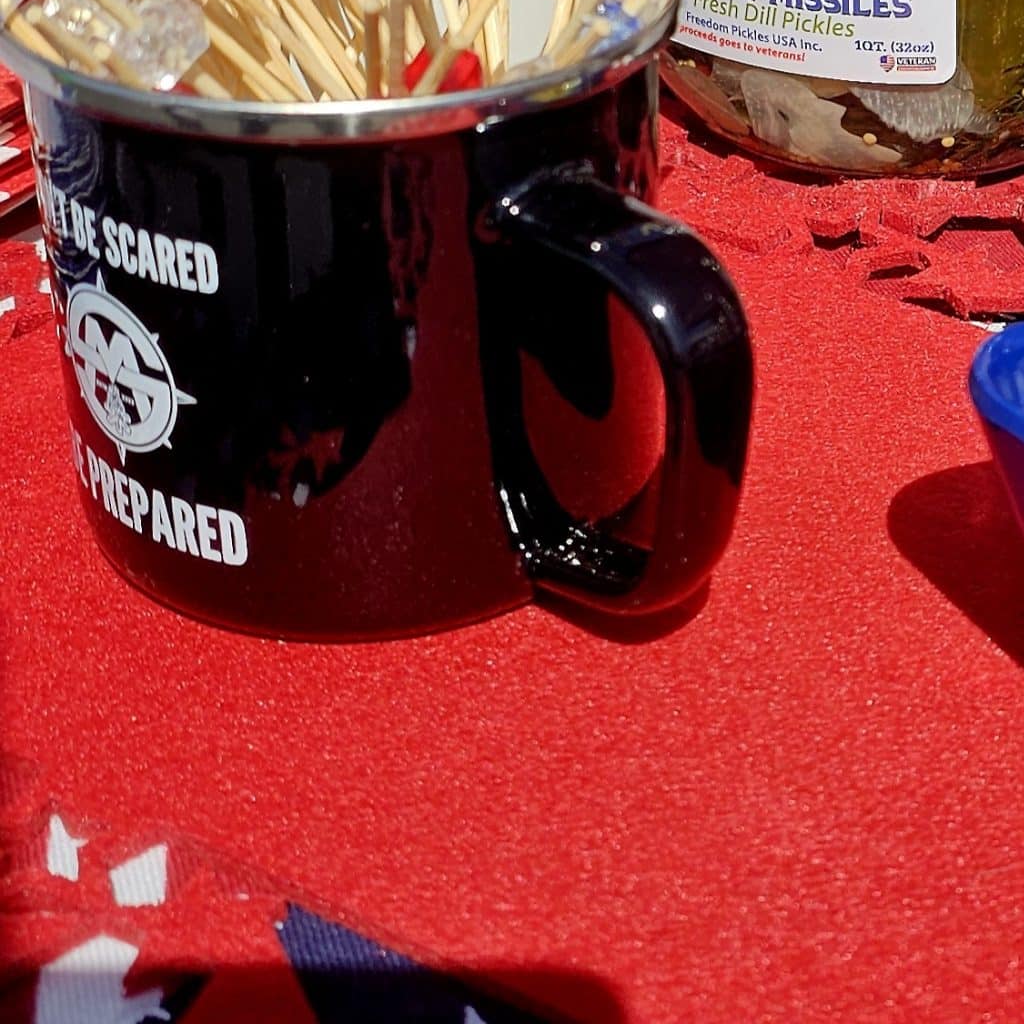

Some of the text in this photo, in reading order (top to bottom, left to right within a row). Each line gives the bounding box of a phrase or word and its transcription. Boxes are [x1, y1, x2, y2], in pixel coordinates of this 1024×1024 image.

[686, 11, 823, 52] Freedom Pickles USA Inc.
[744, 3, 778, 27] Dill
[782, 11, 855, 37] Pickles
[680, 25, 806, 62] proceeds goes to veterans!
[855, 40, 935, 53] 1QT. (32oz)
[70, 197, 100, 260] BE
[102, 216, 219, 295] SCARED
[86, 445, 248, 566] PREPARED
